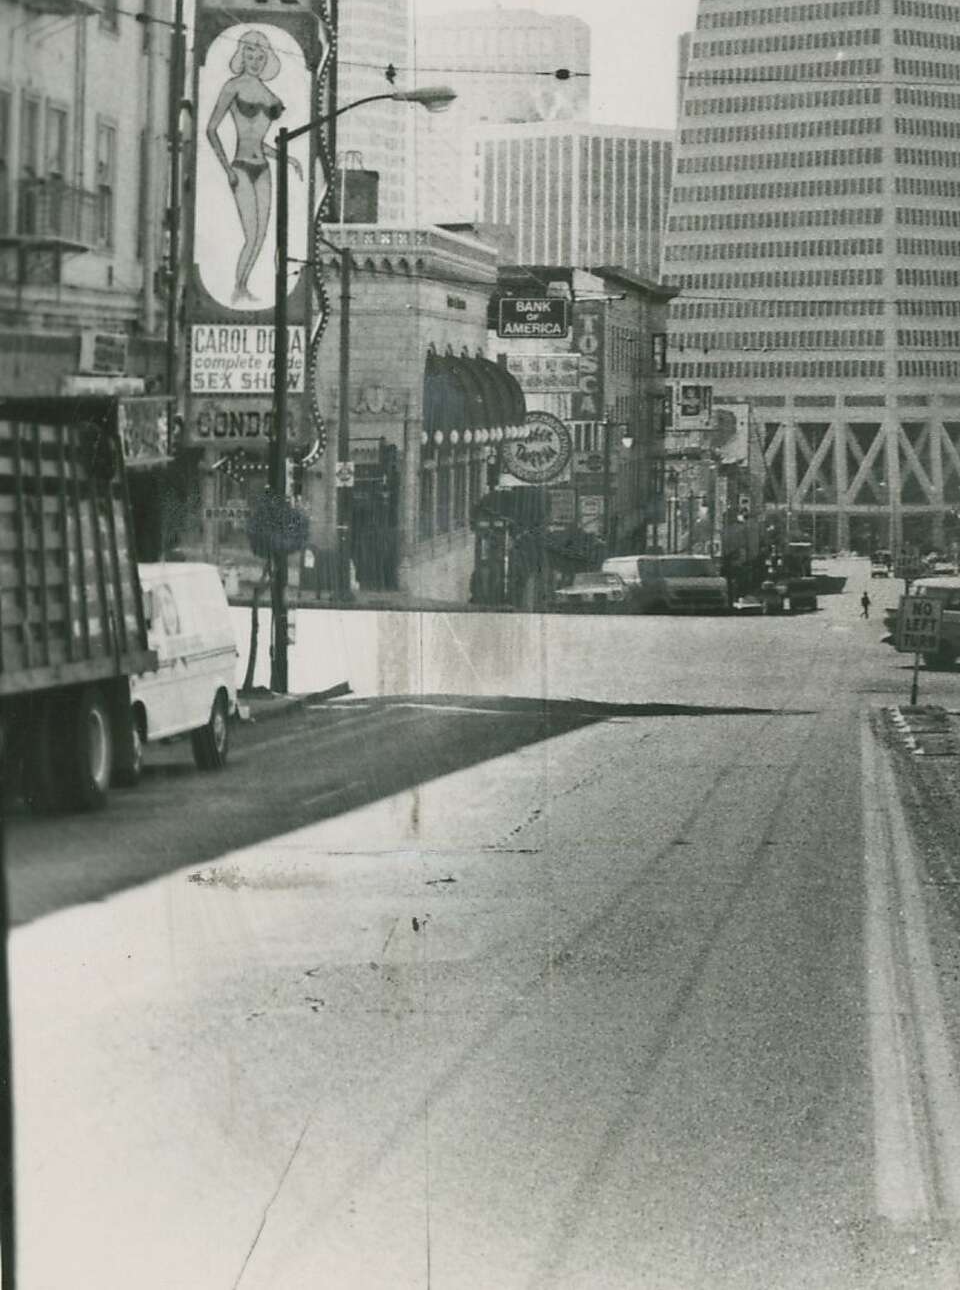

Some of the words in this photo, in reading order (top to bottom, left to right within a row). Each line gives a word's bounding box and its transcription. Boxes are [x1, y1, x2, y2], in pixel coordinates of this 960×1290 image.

[515, 301, 551, 312] BANK
[504, 323, 562, 334] AMERICA
[194, 328, 251, 354] CAROL
[255, 328, 304, 354] DOA
[194, 354, 263, 371] complete
[266, 357, 303, 370] nde
[578, 313, 599, 415] TOSCA
[193, 372, 233, 390] SEX
[911, 601, 932, 617] NO
[905, 617, 938, 631] LEFT
